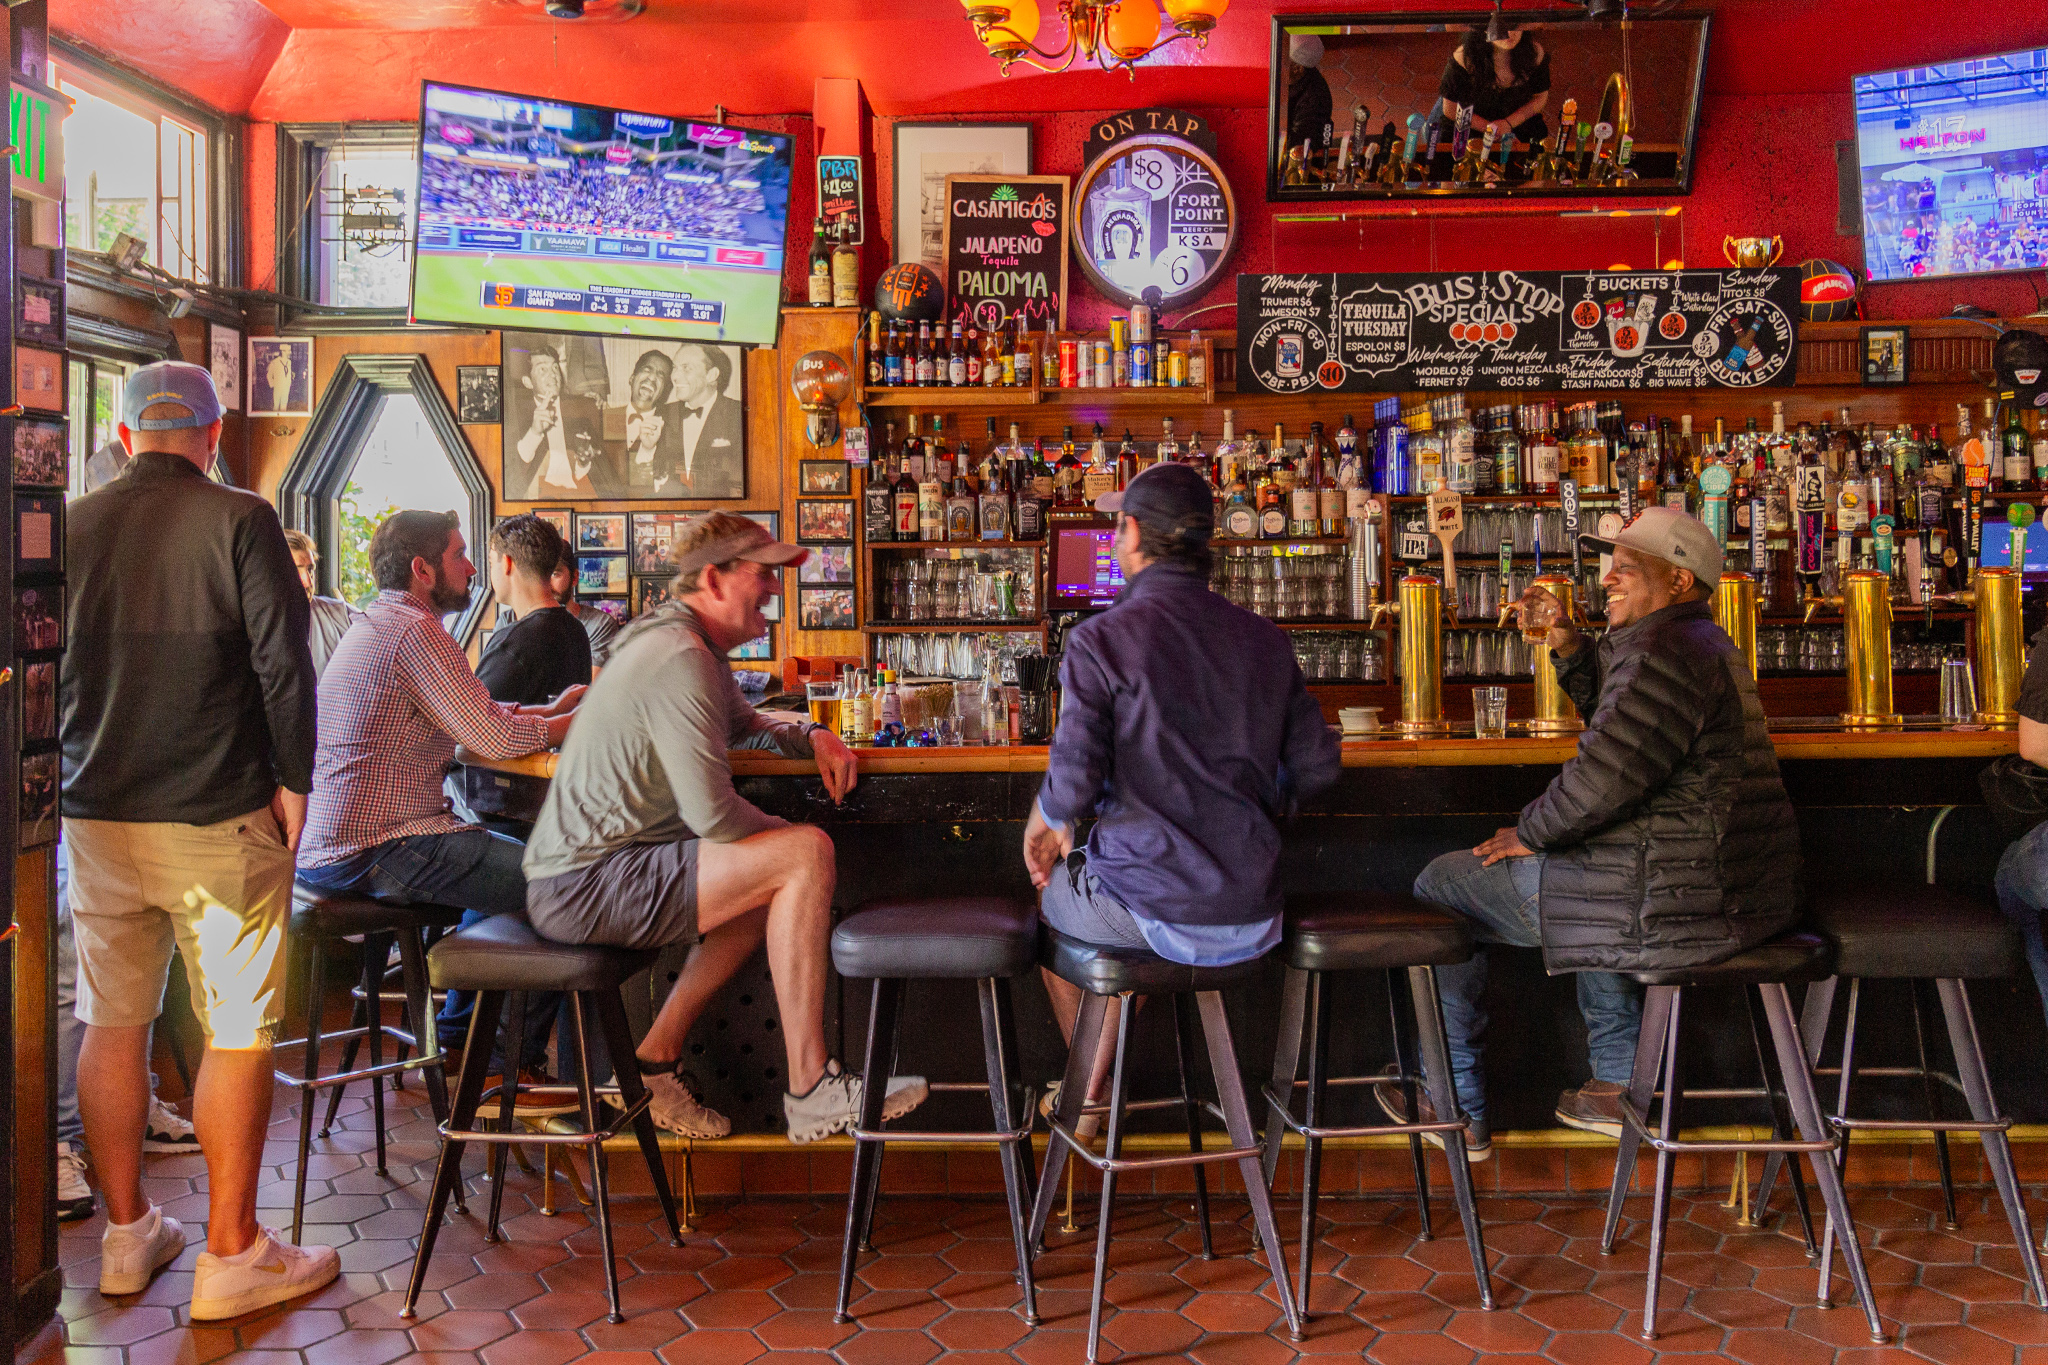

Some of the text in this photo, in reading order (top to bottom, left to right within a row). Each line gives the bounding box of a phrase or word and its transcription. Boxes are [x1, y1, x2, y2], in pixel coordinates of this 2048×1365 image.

[1099, 112, 1199, 141] ON TAP
[10, 87, 51, 183] XIT
[1899, 128, 1987, 150] HELTON
[820, 160, 858, 181] PBR
[1134, 154, 1163, 190] $8
[1178, 194, 1220, 207] FORT
[1174, 208, 1224, 221] POINT
[622, 243, 646, 253] Health
[959, 235, 1043, 255] JALAPEÑO
[980, 254, 1019, 269] Tequila
[1171, 255, 1189, 286] 6
[957, 270, 1049, 298] PALOMA
[1261, 274, 1322, 297] Monday
[1599, 277, 1669, 291] BUCKETS
[1721, 267, 1781, 291] Sunday
[527, 289, 582, 302] SAN FRANCISCO
[1721, 288, 1765, 298] TITO'S $8
[1812, 278, 1849, 297] BRANCA
[527, 297, 554, 308] GIANTS
[1260, 297, 1312, 307] TRUMER $6
[1682, 302, 1715, 315] Saturday
[590, 301, 710, 320] 0-4 3.3 .206 .143 5.91
[980, 305, 997, 322] $8
[1259, 307, 1321, 318] JAMESON $7
[1342, 303, 1407, 319] TEQUILA
[1429, 303, 1535, 324] SPECIALS
[1342, 321, 1408, 337] TUESDAY
[1345, 341, 1406, 352] ESPOLON $8
[1408, 344, 1548, 366] Wednesday Thursday
[1568, 351, 1616, 372] Friday
[1636, 351, 1702, 371] Saturday
[1319, 366, 1344, 383] $10
[1415, 366, 1474, 377] MODELO $6
[1481, 365, 1512, 375] UNION
[1515, 364, 1555, 374] MEZCAL
[1657, 368, 1707, 378] BULLEIT $9
[1710, 353, 1784, 385] BUCKETS
[1419, 377, 1469, 387] FERNET $7
[1500, 376, 1540, 387] 805 $6
[1561, 379, 1641, 389] STASH PANDA $6
[1649, 378, 1707, 388] BIG WAVE $6
[1563, 482, 1578, 528] 805
[898, 503, 915, 530] 7
[1755, 503, 1766, 568] BUD LIGHT
[1404, 540, 1426, 555] IPA
